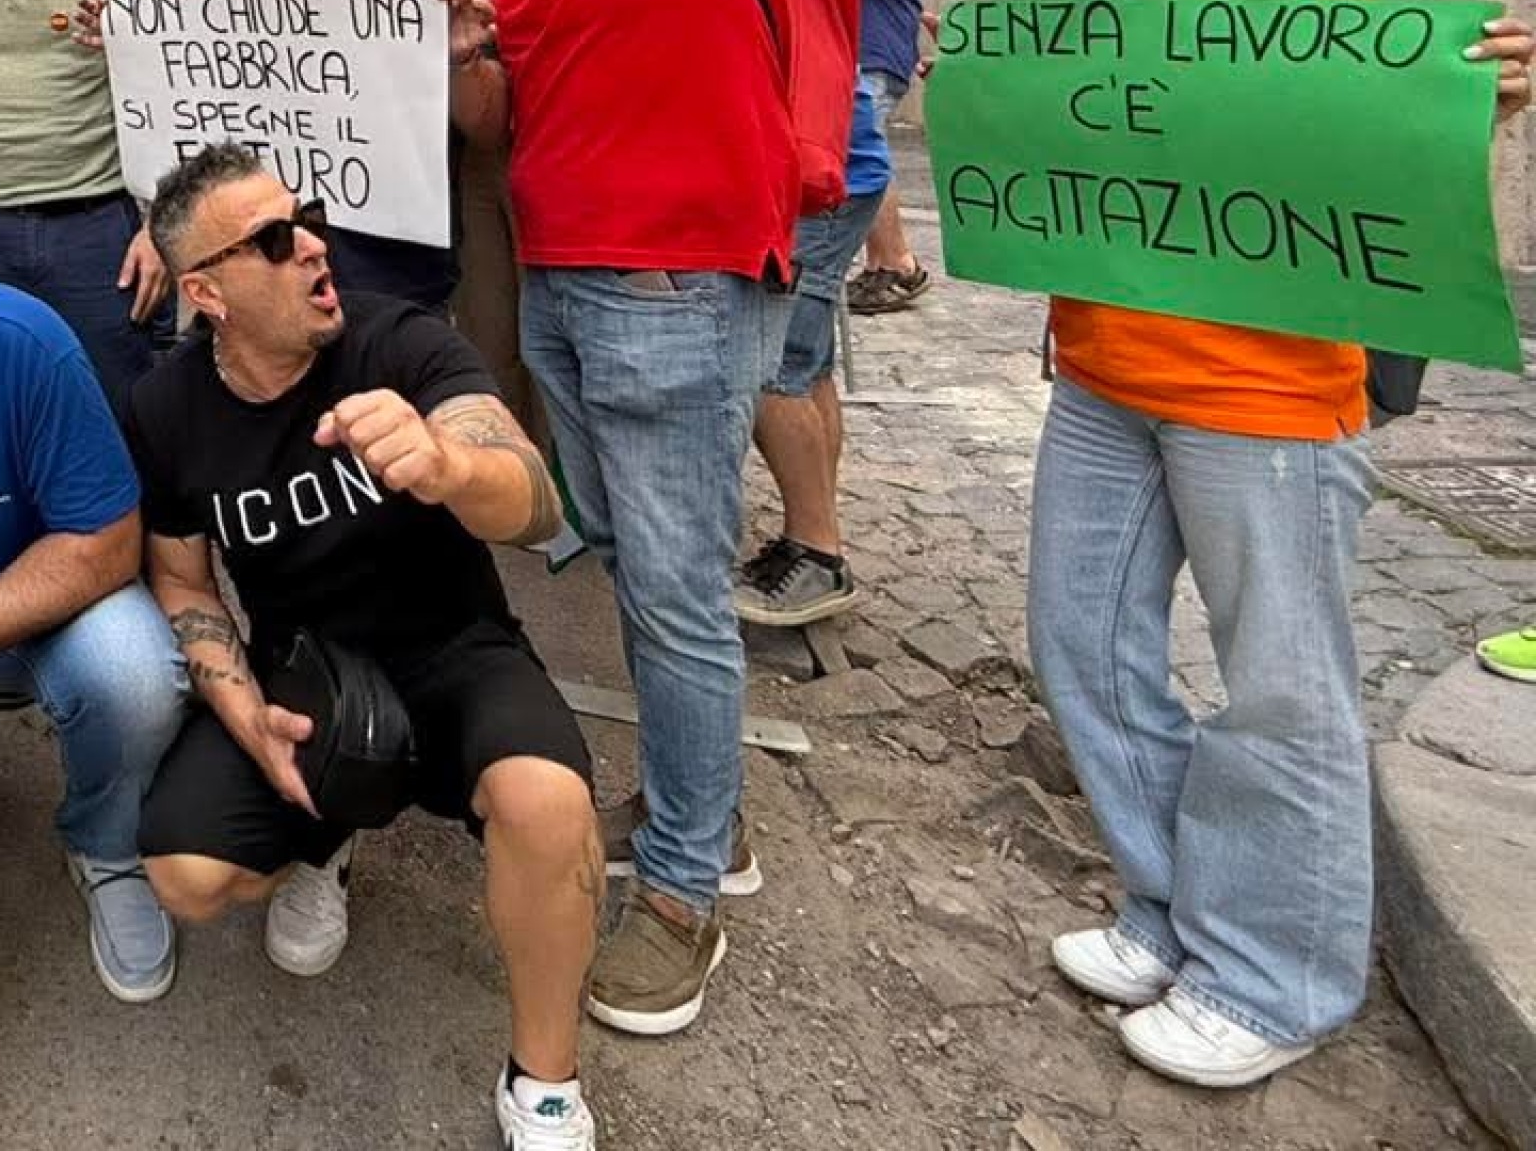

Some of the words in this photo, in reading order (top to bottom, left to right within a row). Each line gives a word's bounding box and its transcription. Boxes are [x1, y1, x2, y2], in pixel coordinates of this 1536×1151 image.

[938, 0, 1124, 59] SENZA
[1165, 0, 1434, 68] LAVORO
[160, 40, 360, 102] FABBRICA,
[122, 99, 155, 131] SI
[172, 100, 316, 141] SPEGNE
[336, 116, 371, 146] IL
[173, 139, 371, 209] FTURO
[948, 164, 1424, 294] AGITAZIONE
[212, 453, 384, 549] ICON
